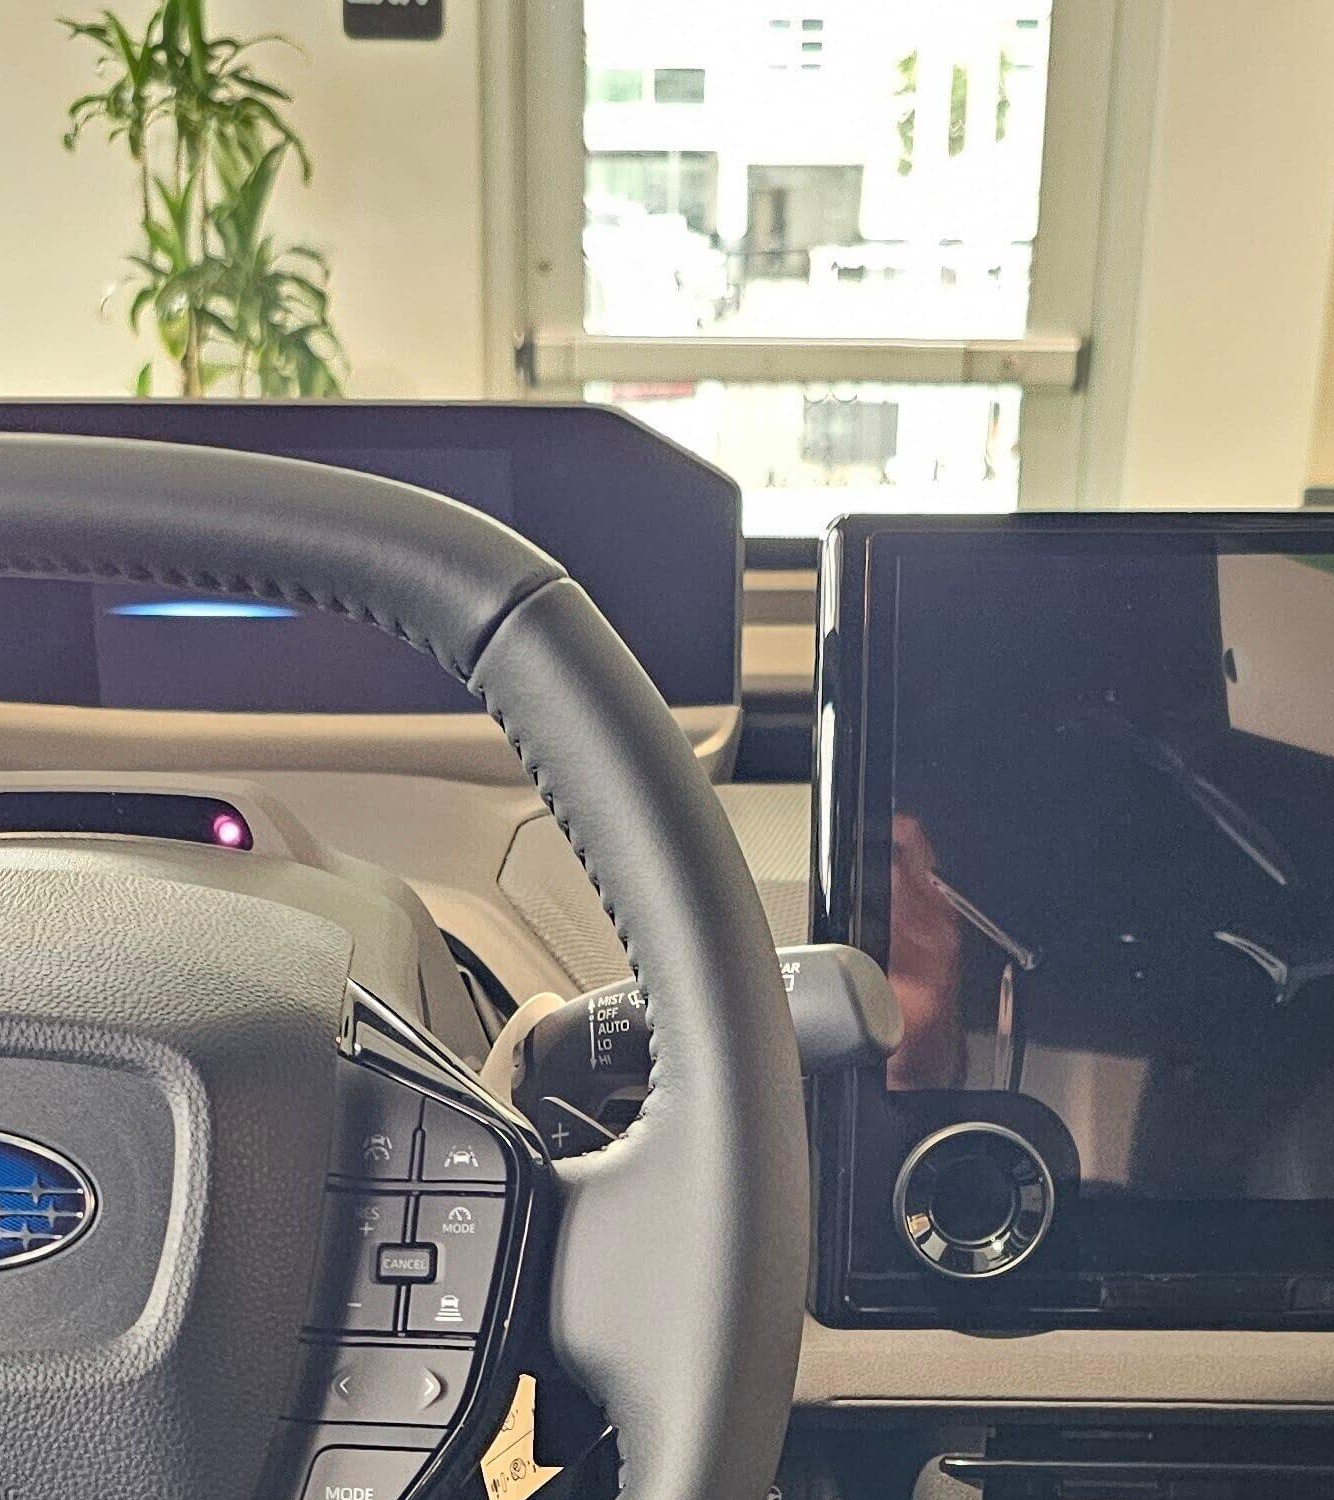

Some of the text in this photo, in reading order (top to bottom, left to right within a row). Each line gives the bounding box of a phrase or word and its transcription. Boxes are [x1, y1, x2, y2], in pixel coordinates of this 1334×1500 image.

[597, 992, 624, 1009] MIST
[596, 1007, 618, 1022] OFF
[598, 1019, 630, 1036] AUTO
[597, 1037, 613, 1052] LO
[599, 1053, 612, 1067] HI
[442, 1223, 476, 1235] MODE
[384, 1258, 427, 1271] CANCEL
